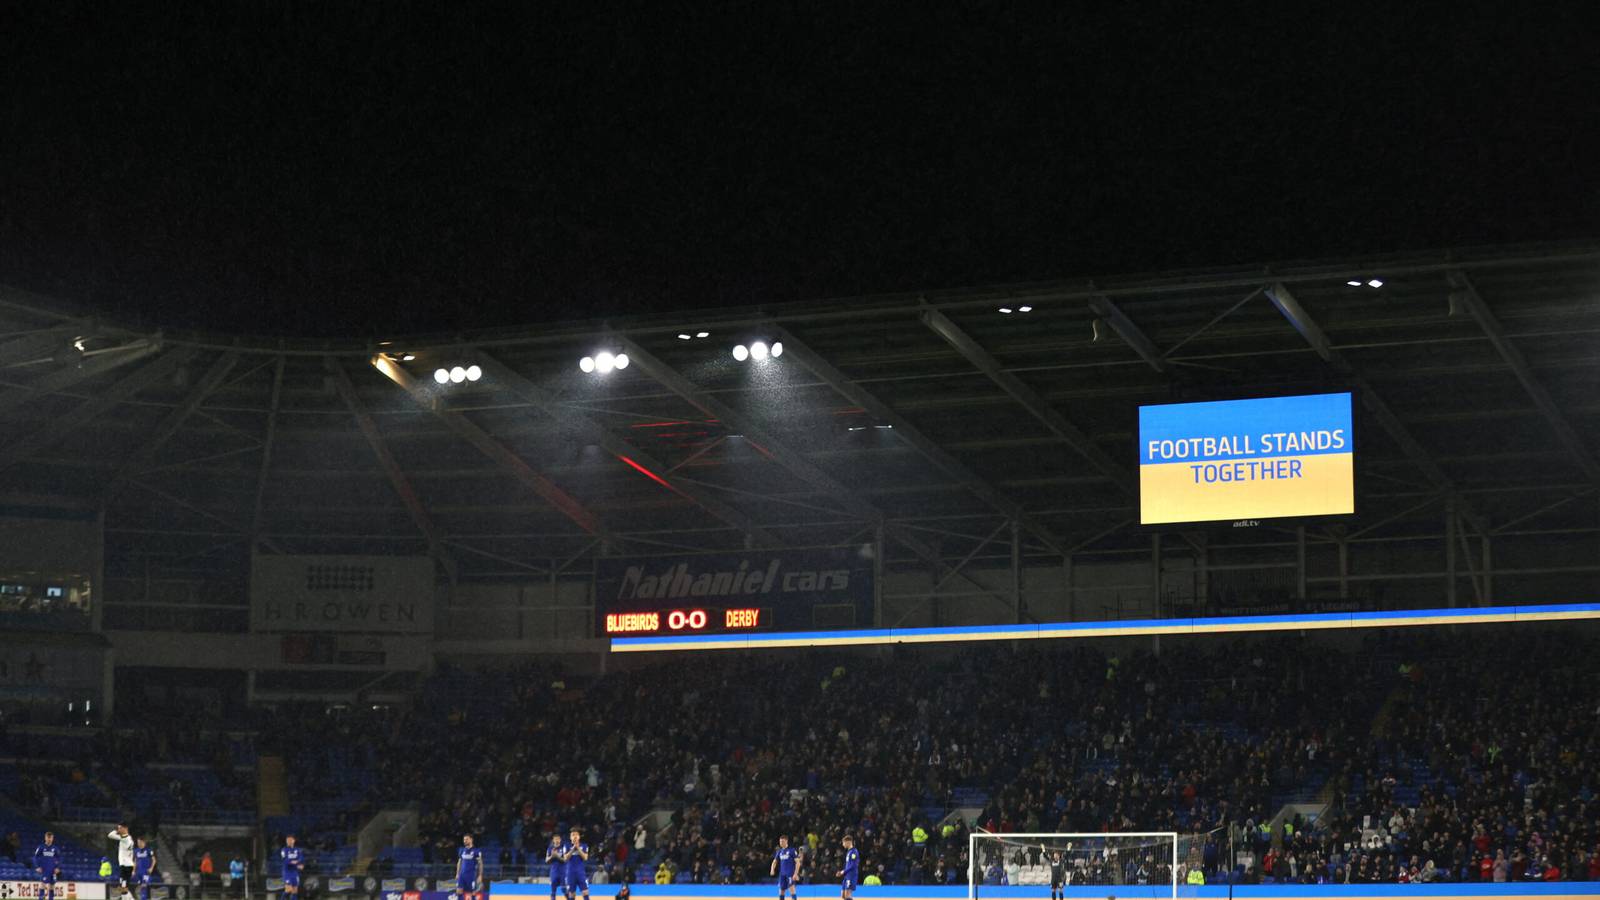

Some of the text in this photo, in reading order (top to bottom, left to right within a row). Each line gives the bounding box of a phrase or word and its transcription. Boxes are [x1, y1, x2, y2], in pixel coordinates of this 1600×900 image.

[1148, 429, 1345, 460] FOOTBALL STANDS
[1190, 459, 1302, 483] TOGETHER
[617, 559, 850, 601] Nathaniel cars
[606, 613, 659, 632] BLUEBIRDS
[726, 609, 759, 627] DERBY
[17, 883, 31, 897] Ted
